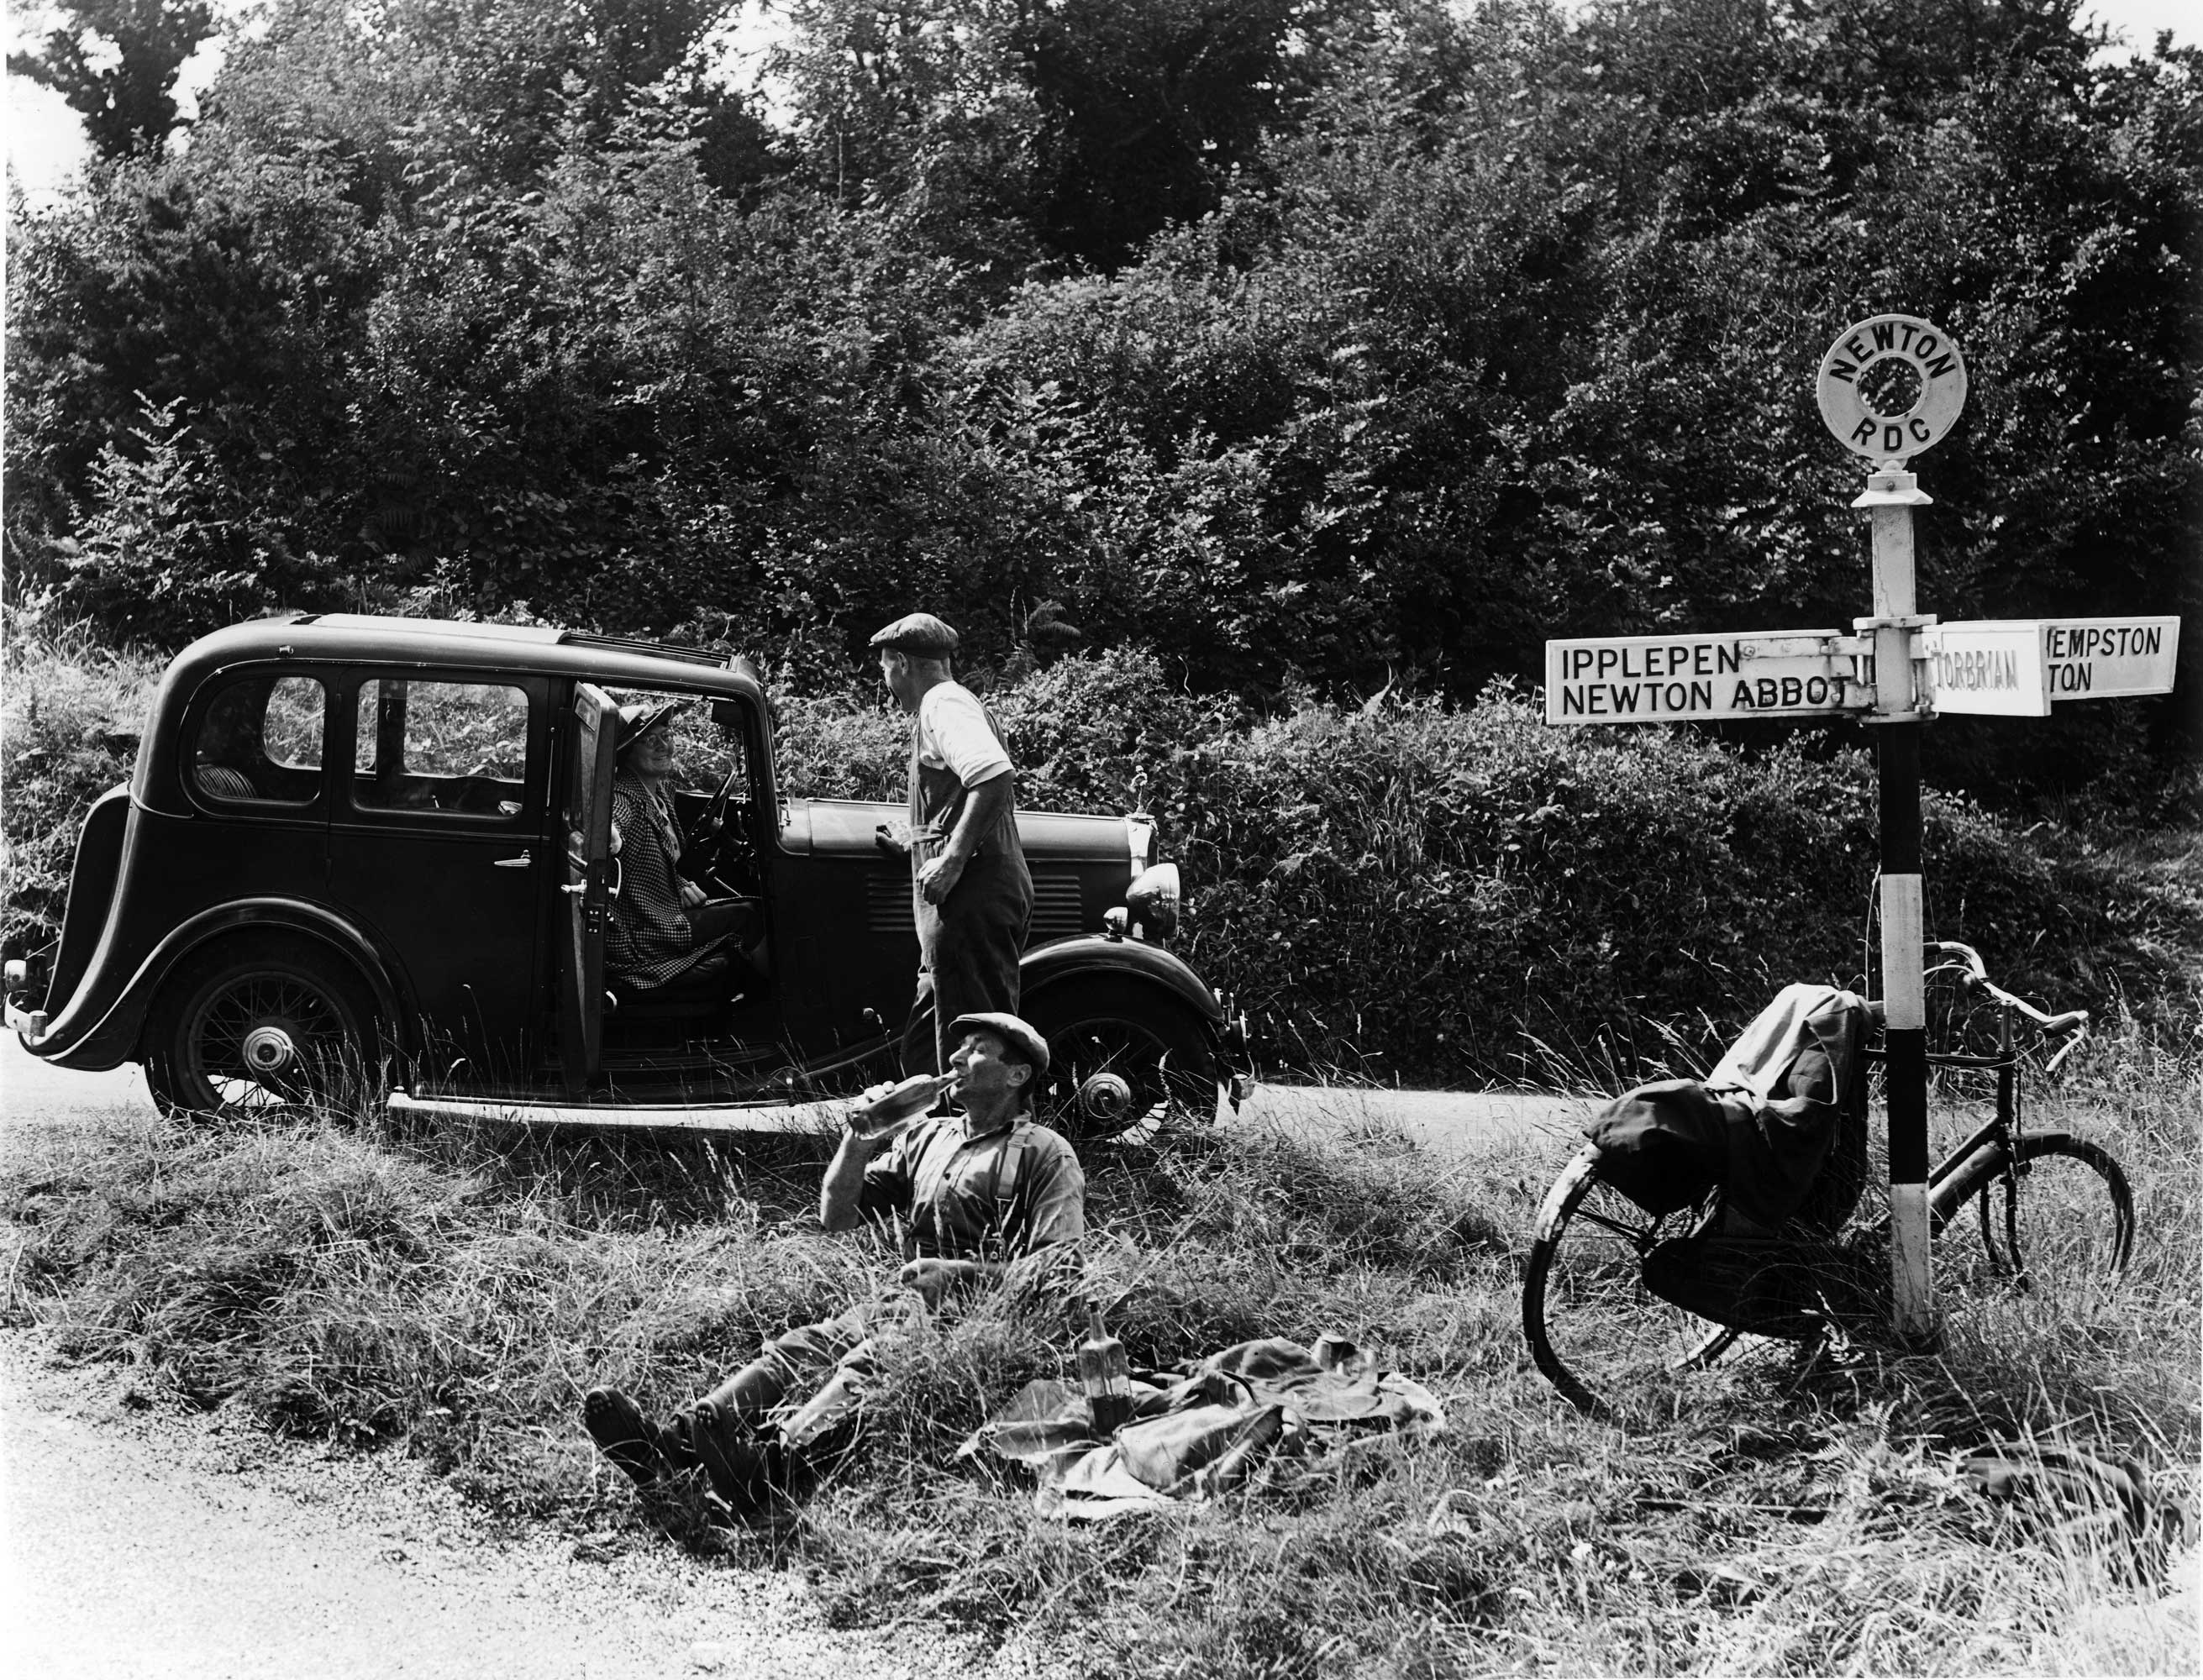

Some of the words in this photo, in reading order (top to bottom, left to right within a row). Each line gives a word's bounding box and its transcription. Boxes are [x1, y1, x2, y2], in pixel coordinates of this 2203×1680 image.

[1829, 323, 1957, 384] NEWTON
[1851, 417, 1931, 452] RDC
[1562, 643, 1740, 680] IPPLEPEN
[1562, 680, 1712, 716] NEWTON
[1731, 675, 1852, 708] ABBOT
